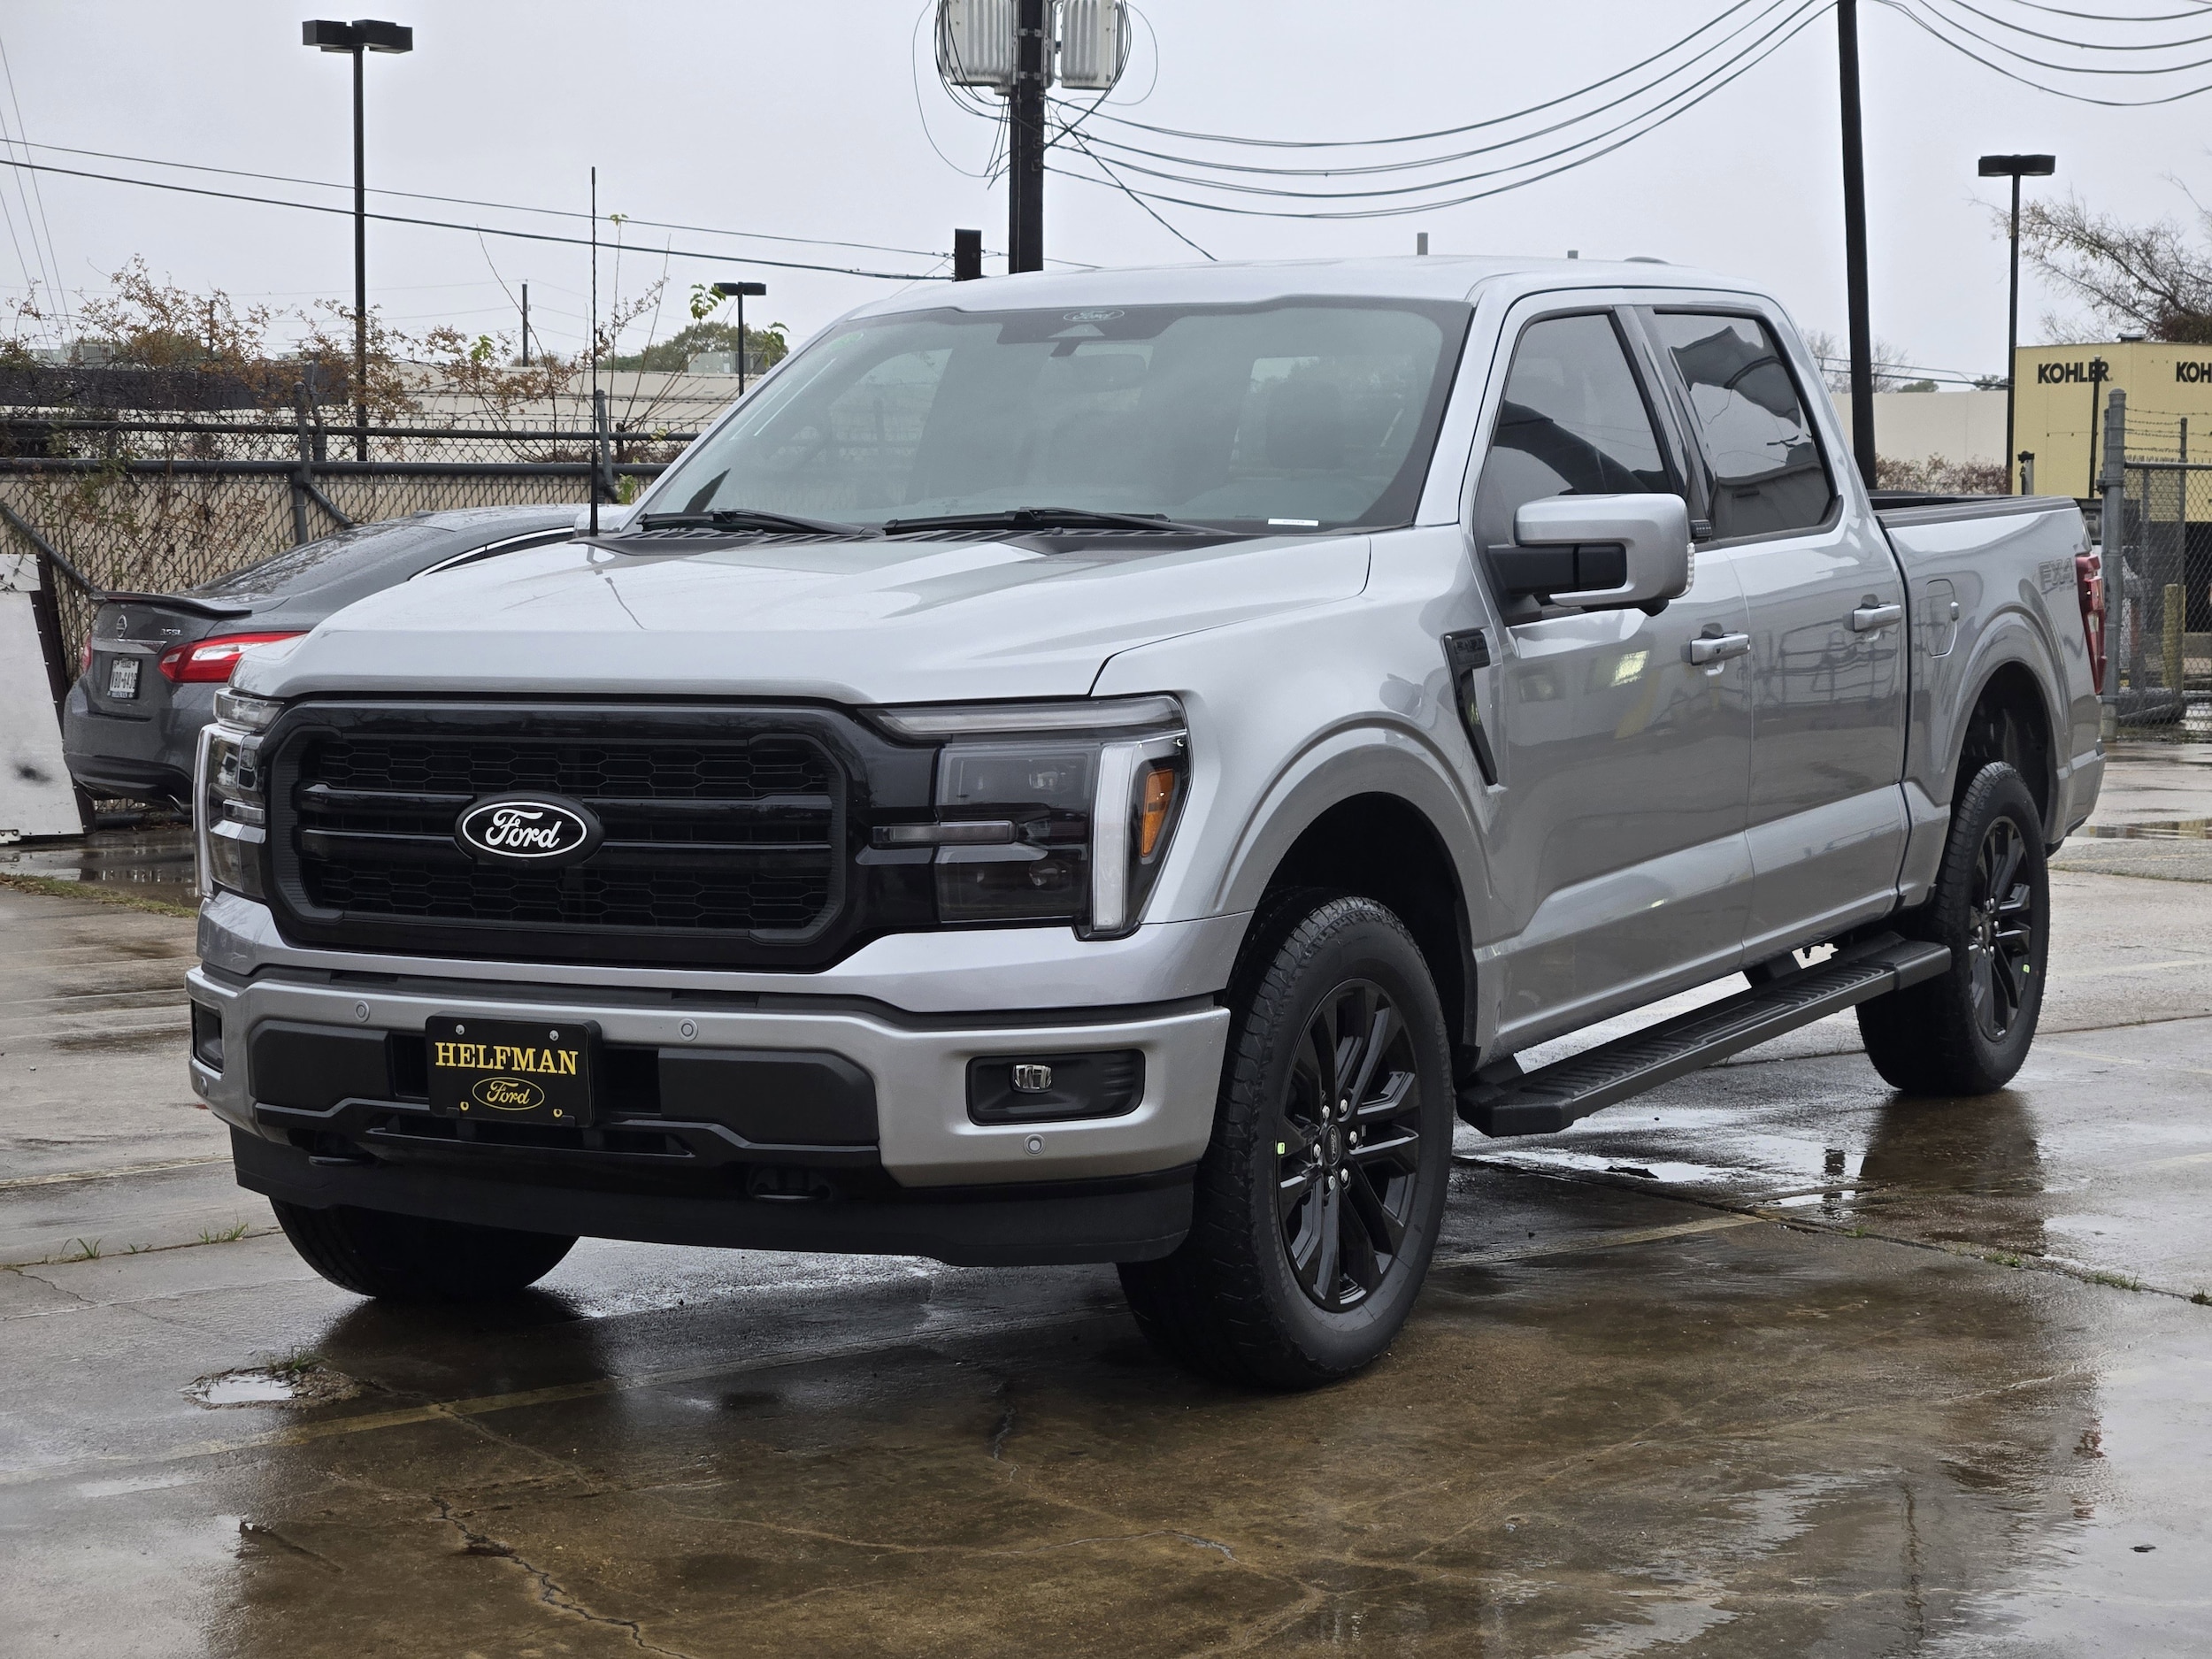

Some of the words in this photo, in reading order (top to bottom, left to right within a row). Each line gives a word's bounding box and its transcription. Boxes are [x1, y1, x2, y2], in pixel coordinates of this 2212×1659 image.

[2038, 361, 2109, 383] KOHLER
[485, 809, 562, 849] Ford
[435, 1042, 579, 1075] HELFMAN
[487, 1079, 531, 1104] Ford
